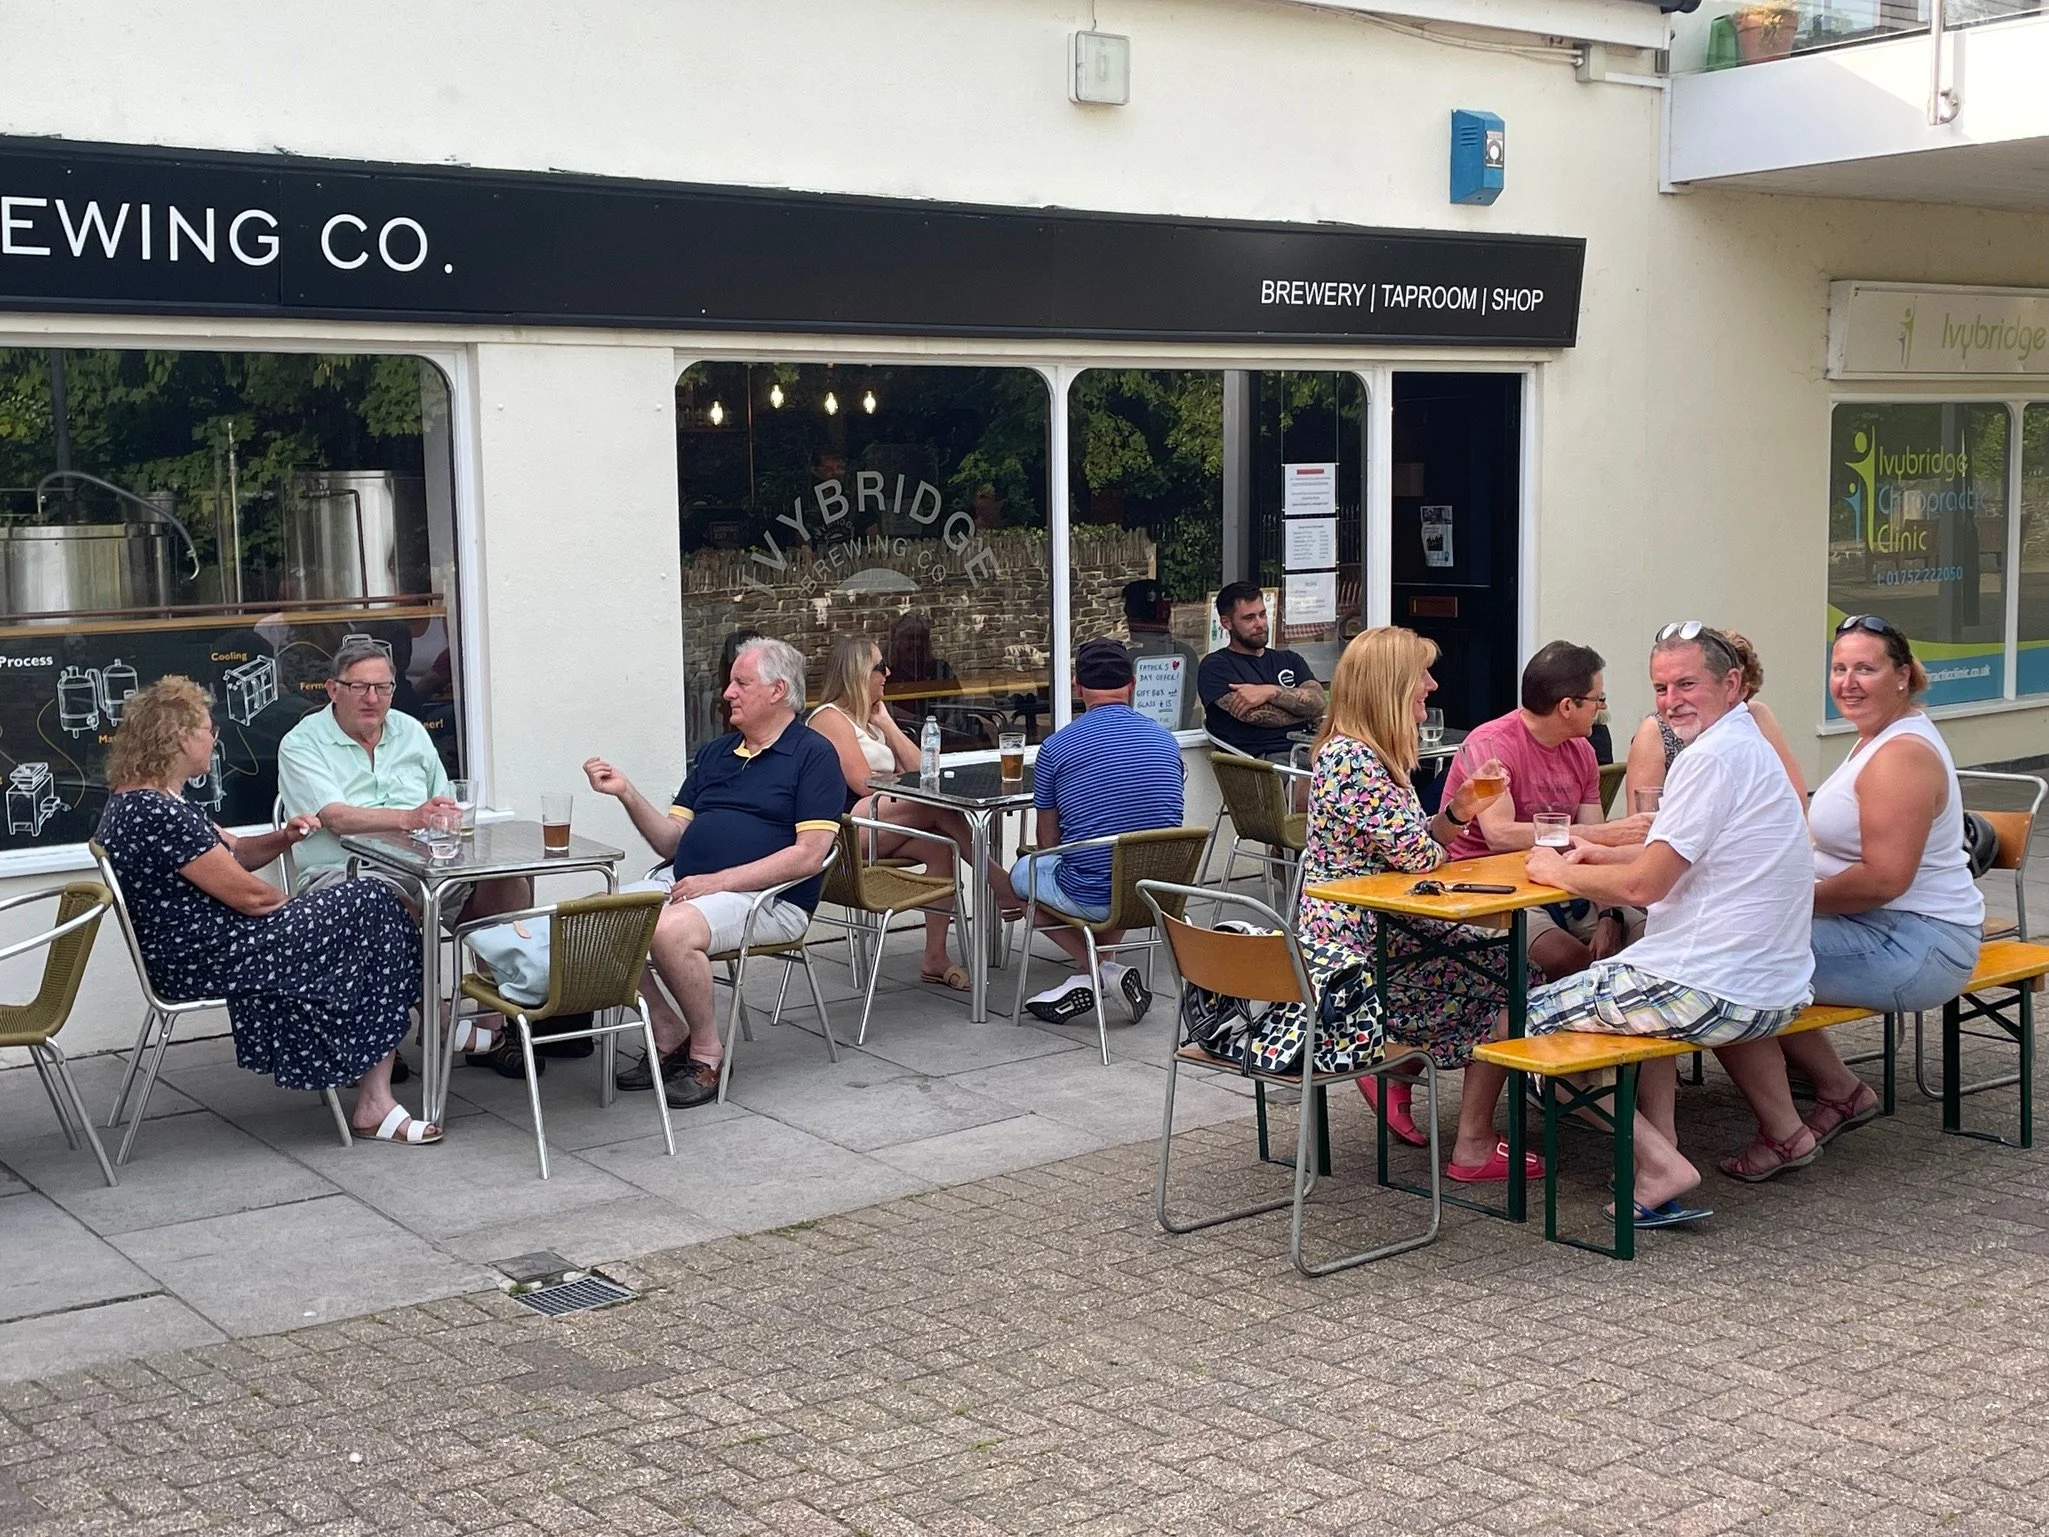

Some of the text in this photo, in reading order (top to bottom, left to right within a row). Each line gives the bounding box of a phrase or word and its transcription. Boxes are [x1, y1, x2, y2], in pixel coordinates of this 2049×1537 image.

[1, 196, 454, 275] EWING CO.
[1260, 279, 1545, 312] BREWERY TAPROOM SHOP
[1941, 312, 2048, 361] Ivybridge
[1879, 445, 1969, 484] Ivybridge
[1878, 483, 1988, 521] Chopractic
[740, 469, 1001, 598] IVYBRIDGE
[1877, 522, 1928, 554] Clinic
[800, 534, 948, 596] BREWING CO
[1886, 569, 1920, 586] 01752
[1923, 566, 1964, 584] 222050
[0, 656, 54, 668] Process
[211, 650, 248, 662] Cooling
